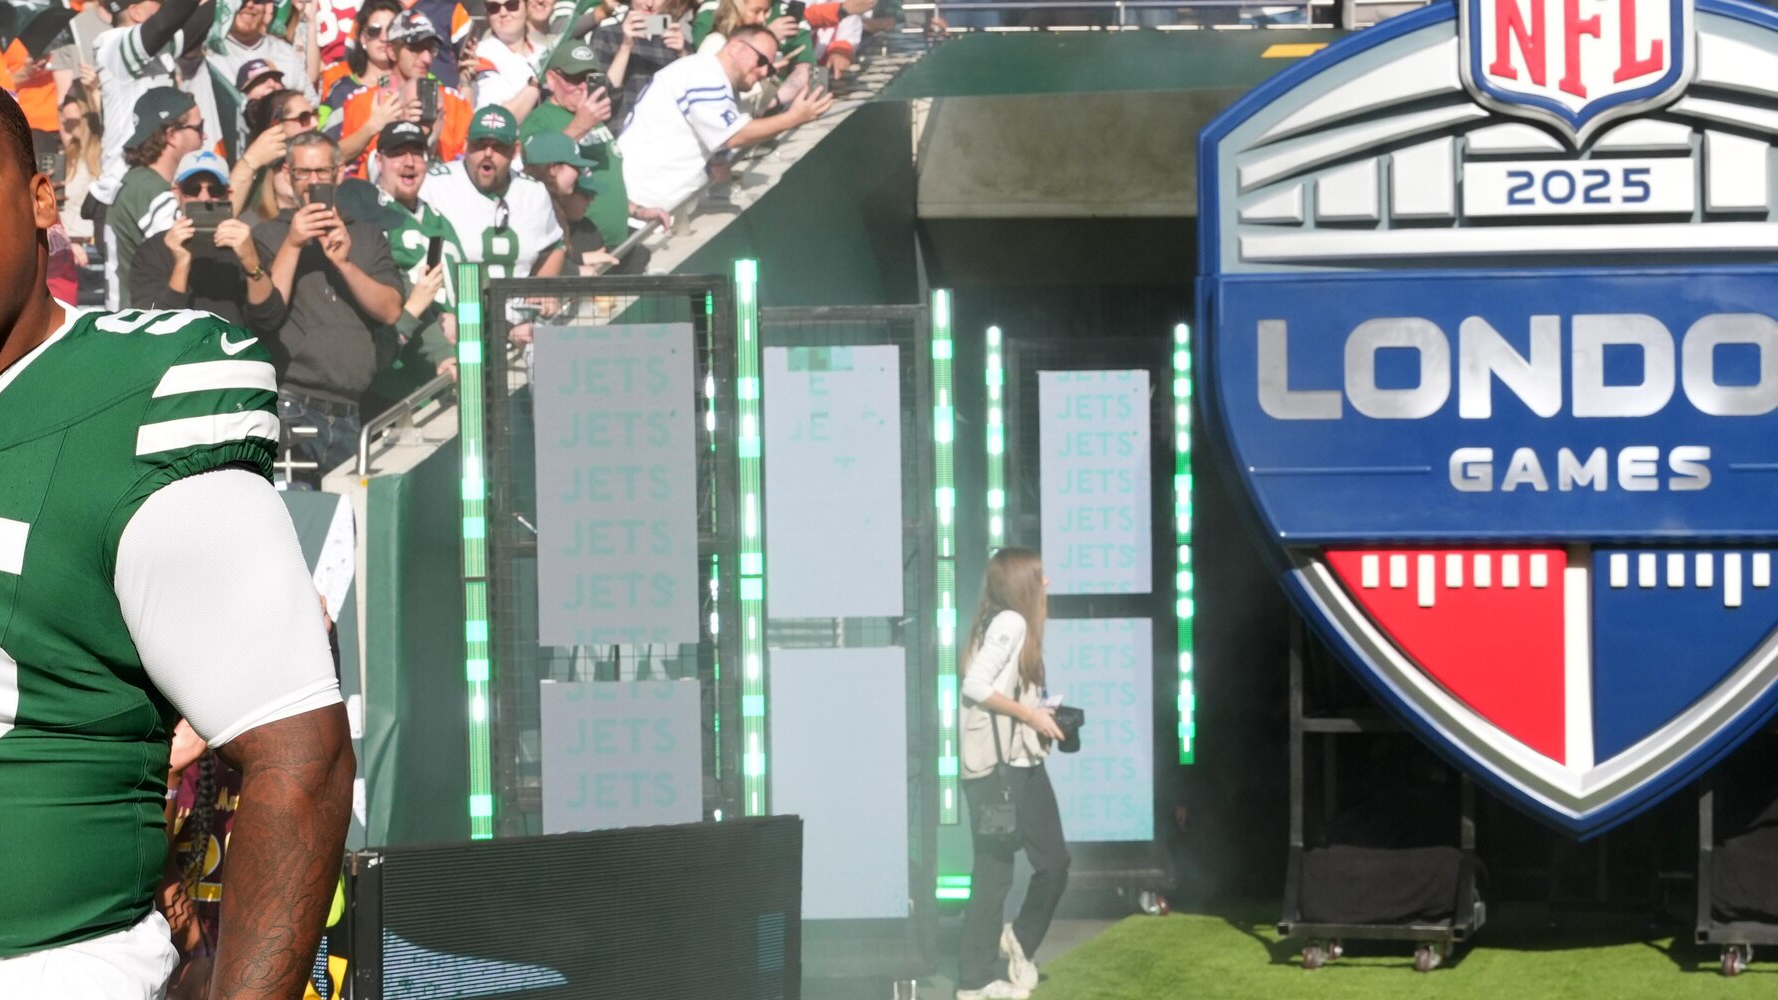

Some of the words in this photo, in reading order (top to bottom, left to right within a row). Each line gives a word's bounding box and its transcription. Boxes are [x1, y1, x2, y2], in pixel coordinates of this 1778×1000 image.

[1489, 0, 1664, 99] NFL
[1507, 167, 1651, 205] 2025
[557, 356, 672, 396] JETS
[1257, 312, 1778, 420] LONDO
[1056, 393, 1133, 420] JETS
[557, 411, 673, 449] JETS
[1057, 431, 1134, 458] JETS
[559, 465, 674, 504] JETS
[1058, 468, 1135, 495] JETS
[1449, 445, 1711, 492] GAMES
[1059, 506, 1136, 532] JETS
[561, 519, 675, 557] JETS
[1059, 544, 1137, 570] JETS
[562, 573, 678, 610] JETS
[1060, 645, 1136, 670] JETS
[565, 718, 679, 755] JETS
[1082, 719, 1136, 745] ETS
[566, 771, 680, 808] JETS
